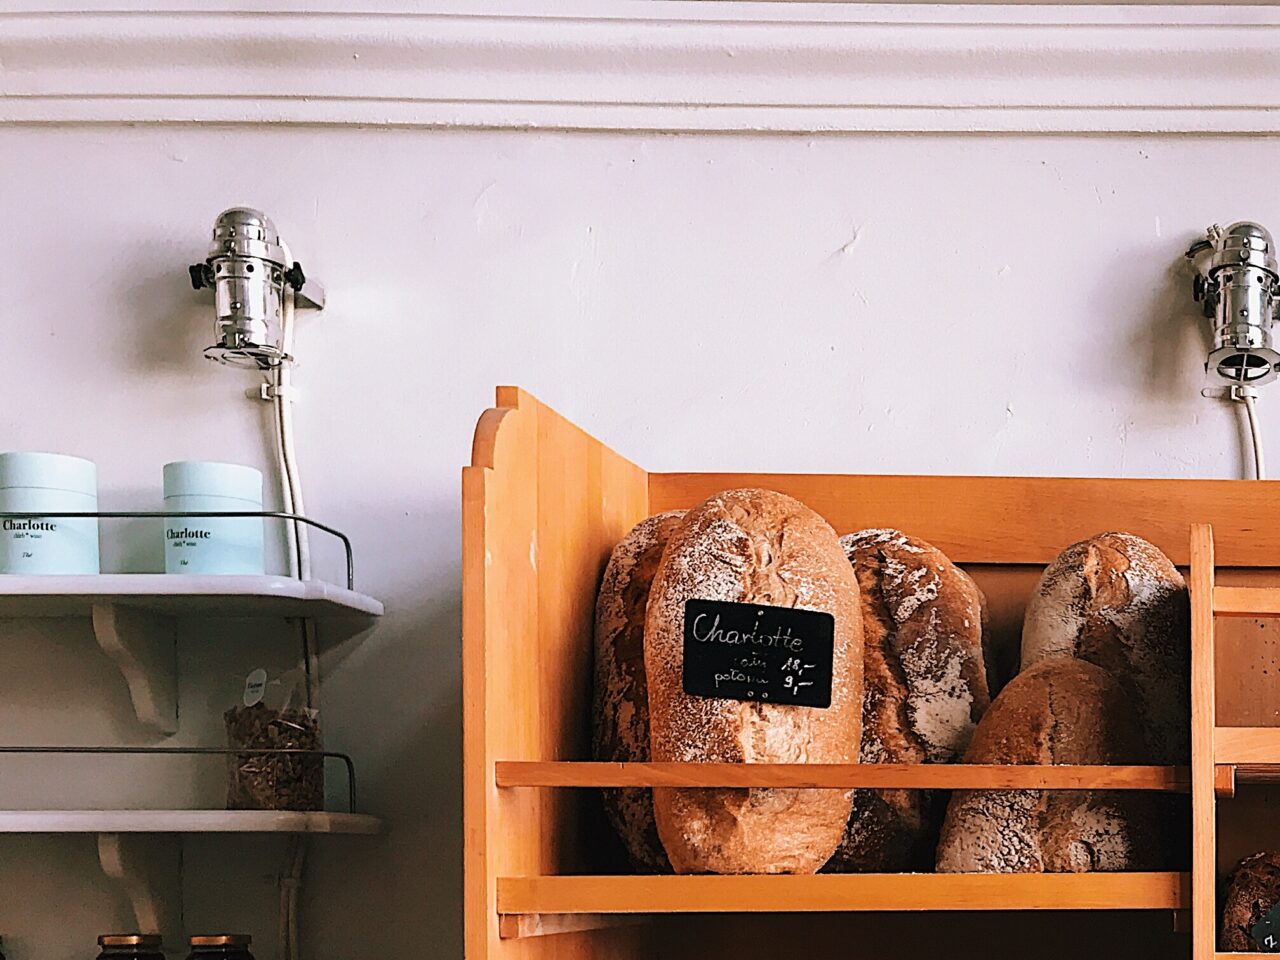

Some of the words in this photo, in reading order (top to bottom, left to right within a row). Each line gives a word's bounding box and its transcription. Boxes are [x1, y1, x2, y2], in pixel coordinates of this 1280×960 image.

[2, 519, 57, 532] Charlotte
[166, 527, 211, 539] Charlotte
[692, 613, 803, 653] Charlotte
